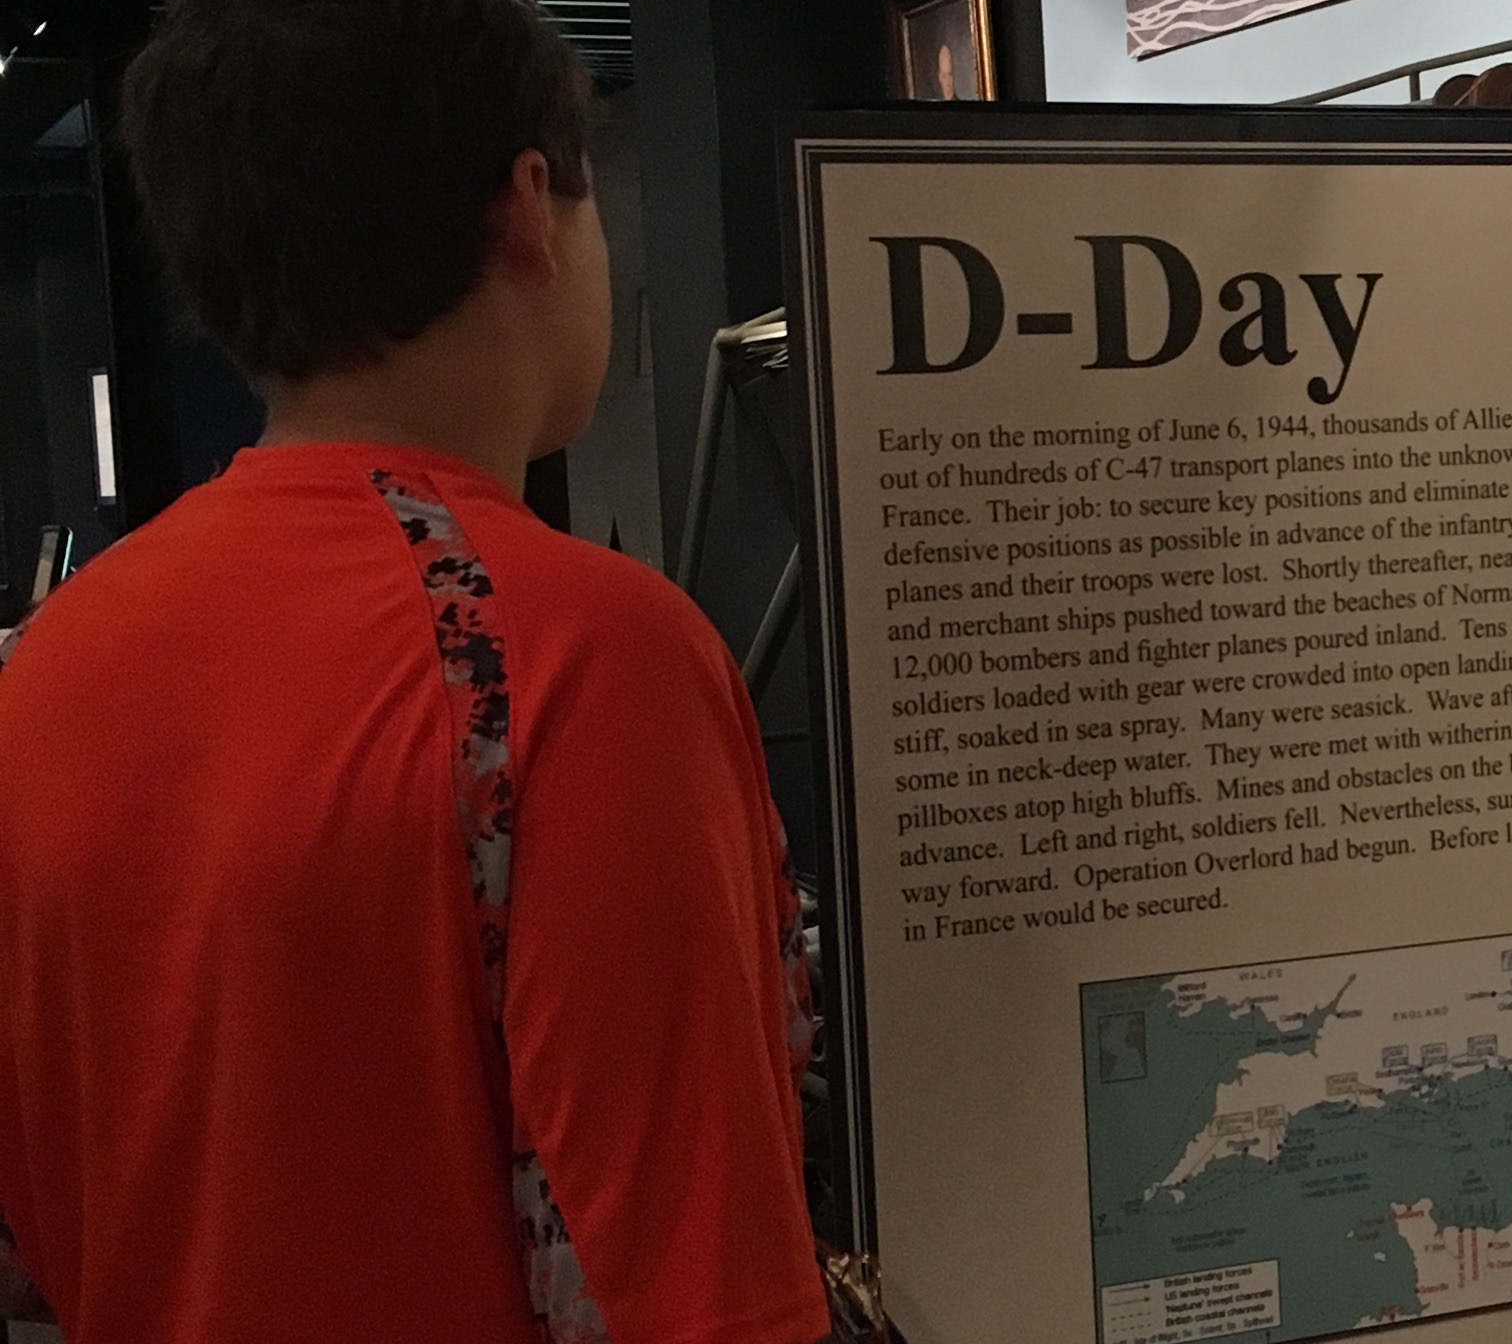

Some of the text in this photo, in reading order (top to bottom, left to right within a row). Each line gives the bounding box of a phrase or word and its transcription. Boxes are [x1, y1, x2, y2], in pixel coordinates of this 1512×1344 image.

[868, 235, 1384, 405] D-Day
[877, 426, 943, 457] Early
[950, 431, 982, 450] on
[988, 424, 1025, 449] the
[1032, 421, 1132, 450] morning
[1137, 420, 1164, 444] of
[1167, 417, 1221, 443] June
[1226, 416, 1248, 442] 6,
[1257, 414, 1316, 439] 1944,
[1322, 410, 1429, 436] thousands
[1434, 408, 1460, 432] of
[879, 469, 920, 490] out
[925, 463, 955, 489] of
[958, 459, 1068, 487] hundreds
[1074, 457, 1102, 482] of
[1105, 455, 1162, 481] C-47
[1169, 456, 1269, 482] transport
[1275, 450, 1345, 480] planes
[1352, 448, 1394, 470] into
[1399, 446, 1432, 468] the
[881, 504, 972, 529] France.
[985, 497, 1051, 524] Their
[1054, 495, 1102, 527] job:
[1109, 498, 1133, 518] to
[1139, 496, 1211, 517] secure
[1217, 489, 1257, 517] key
[1264, 485, 1363, 516] positions
[1368, 481, 1407, 505] and
[1413, 478, 1510, 503] eliminate
[883, 538, 1000, 567] defensive
[1006, 533, 1113, 567] positions
[1118, 536, 1144, 554] as
[1149, 525, 1242, 559] possible
[1249, 524, 1270, 547] in
[1276, 521, 1365, 546] advance
[1371, 516, 1397, 540] of
[1400, 516, 1432, 538] the
[900, 883, 952, 909] way
[958, 866, 1059, 900] forward.
[1073, 856, 1188, 892] Operation
[1194, 843, 1294, 875] Overlord
[1299, 838, 1340, 865] had
[1345, 837, 1416, 864] begun.
[1430, 826, 1500, 852] Before
[903, 886, 1229, 943] in France would be secured.
